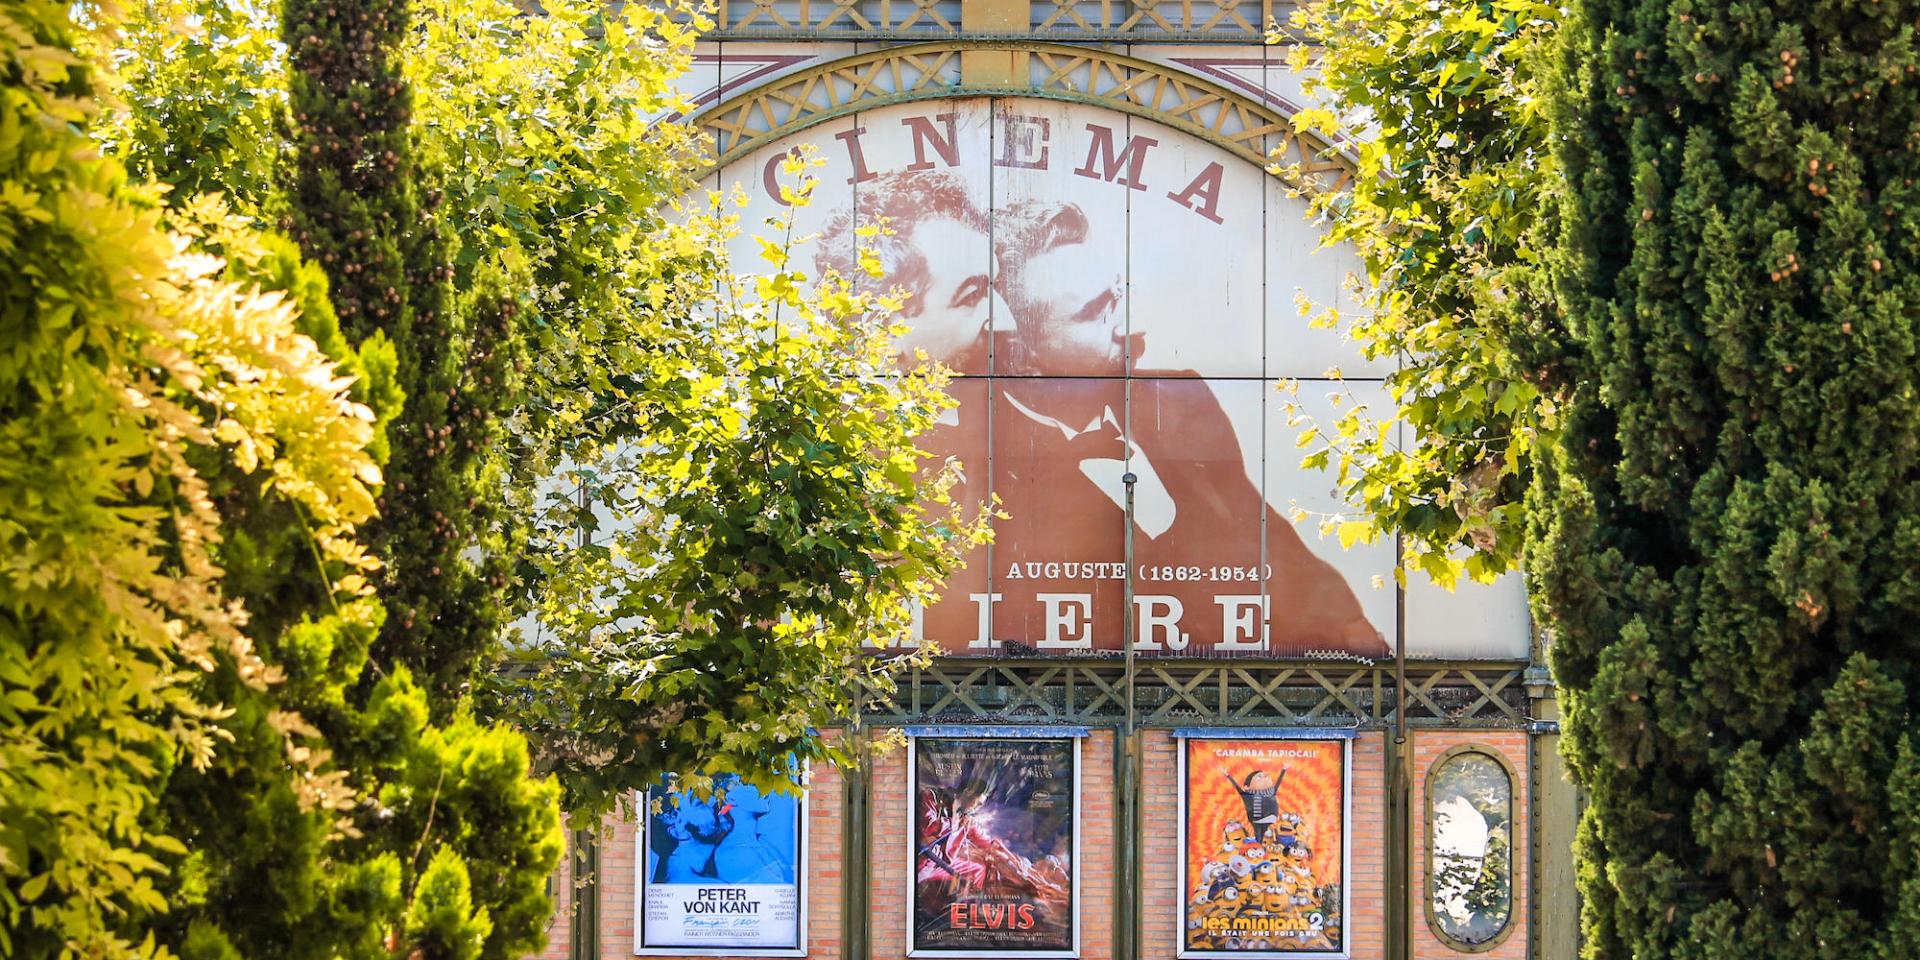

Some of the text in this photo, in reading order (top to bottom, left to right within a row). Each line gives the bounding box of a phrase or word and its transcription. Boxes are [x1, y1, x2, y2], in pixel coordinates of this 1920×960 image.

[763, 112, 1225, 225] CINEMA
[1006, 562, 1272, 582] AUGUSTE (1862-1954)
[698, 888, 746, 901] PETER
[683, 901, 716, 914] VON
[719, 901, 761, 914] KANT
[950, 902, 1036, 930] ELVIS
[1202, 912, 1324, 931] les minions 2
